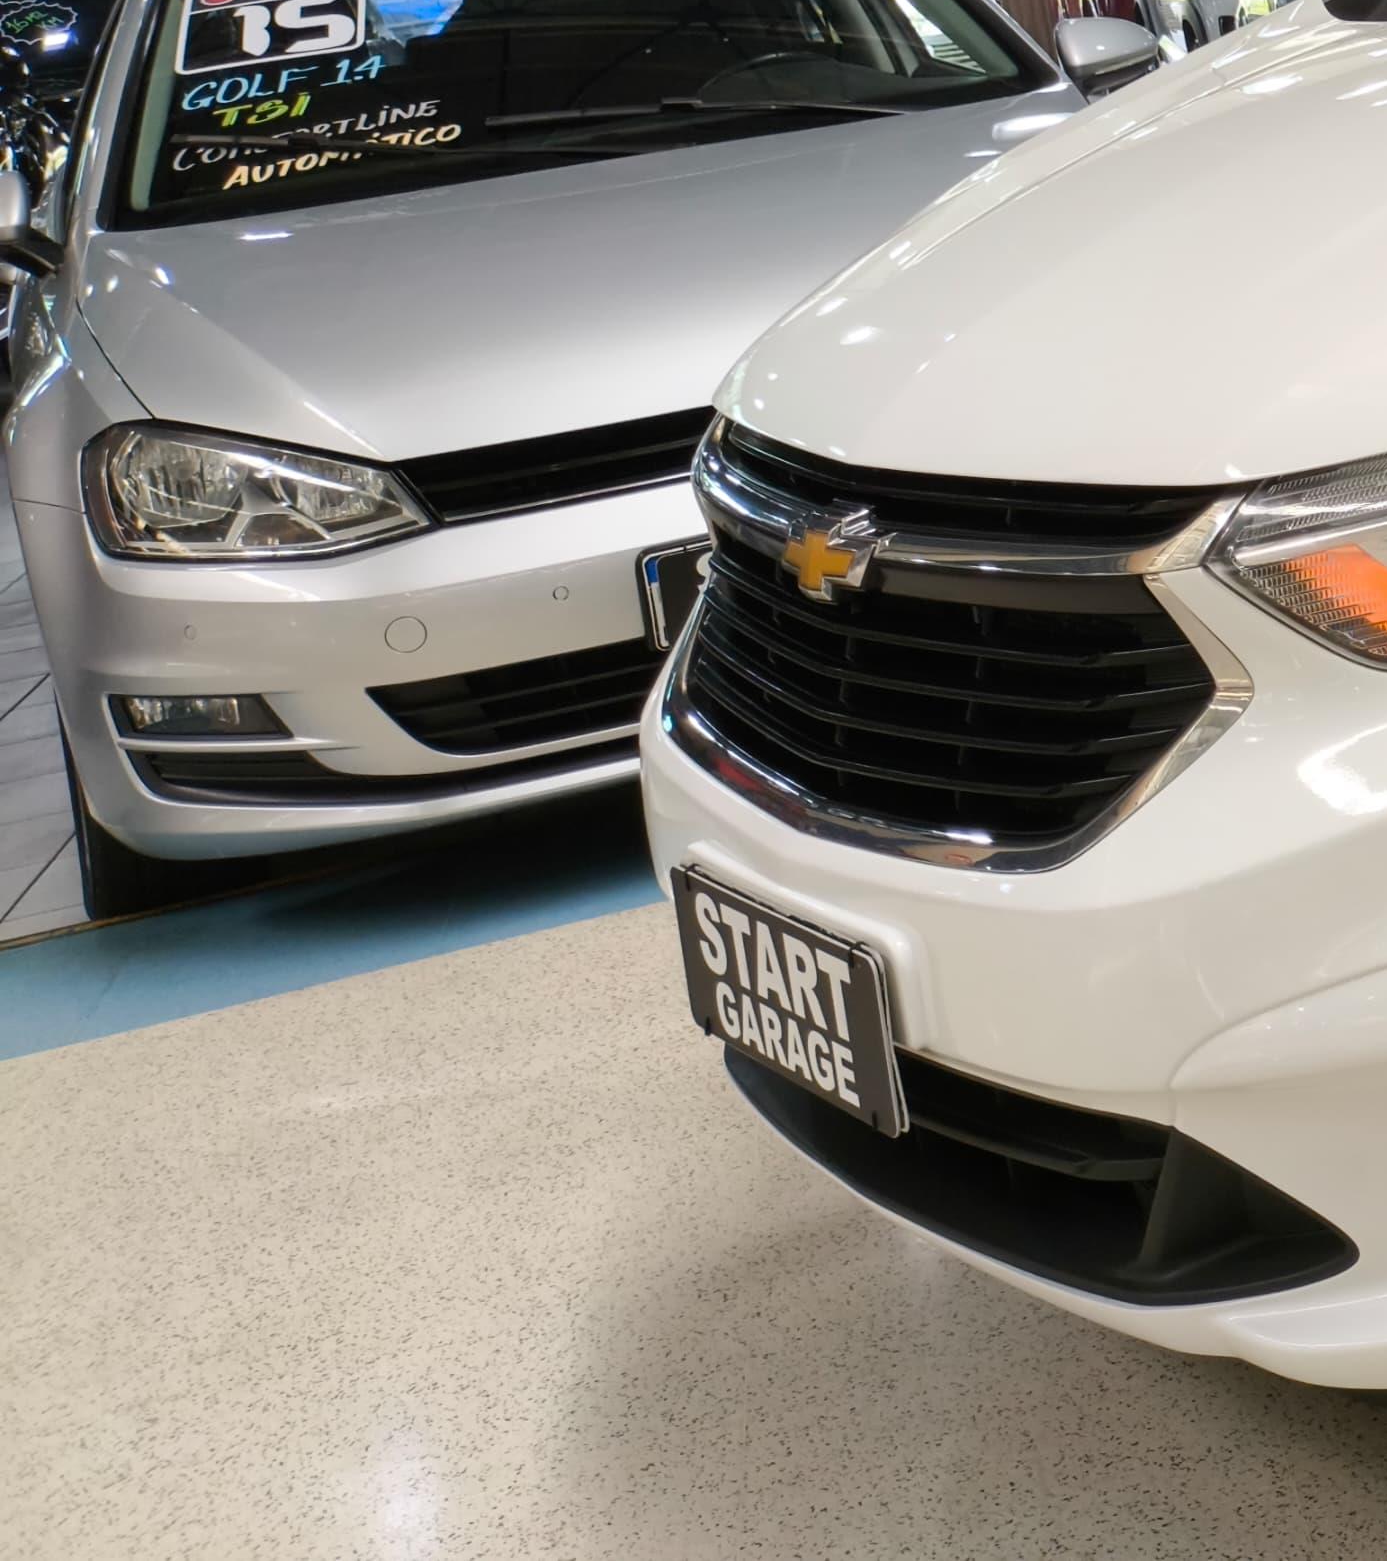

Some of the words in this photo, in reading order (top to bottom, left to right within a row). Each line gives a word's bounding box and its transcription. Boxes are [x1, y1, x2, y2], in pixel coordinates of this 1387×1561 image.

[181, 65, 320, 112] GOLF
[695, 892, 852, 1042] START
[715, 981, 862, 1109] GARAGE
